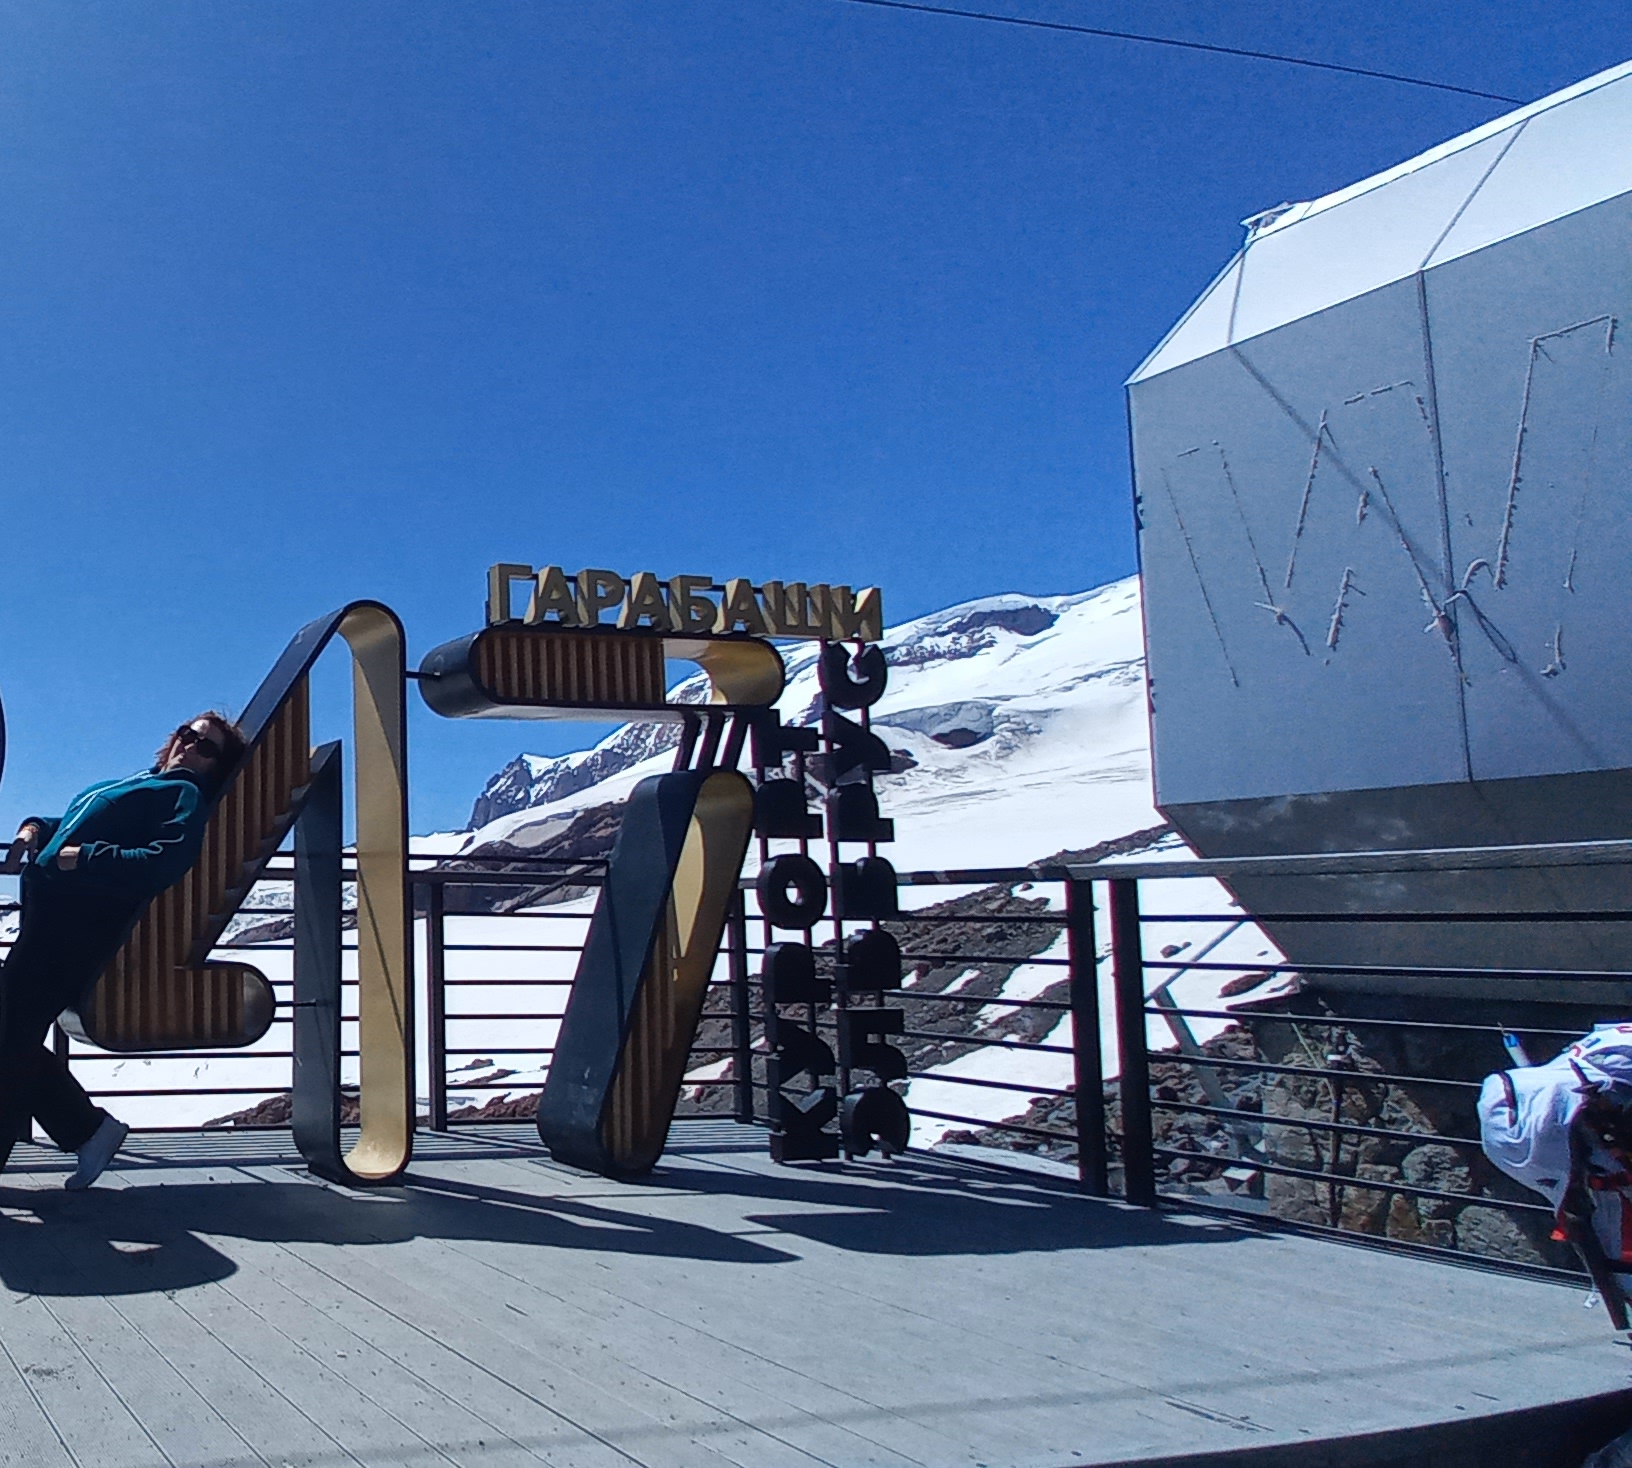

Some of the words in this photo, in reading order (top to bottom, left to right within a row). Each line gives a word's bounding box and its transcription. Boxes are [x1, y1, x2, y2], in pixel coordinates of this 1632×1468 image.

[487, 562, 883, 642] ГАРАБАШИ
[746, 708, 839, 1162] КУРОРТ
[821, 641, 911, 1158] ЭЛЬБРУС
